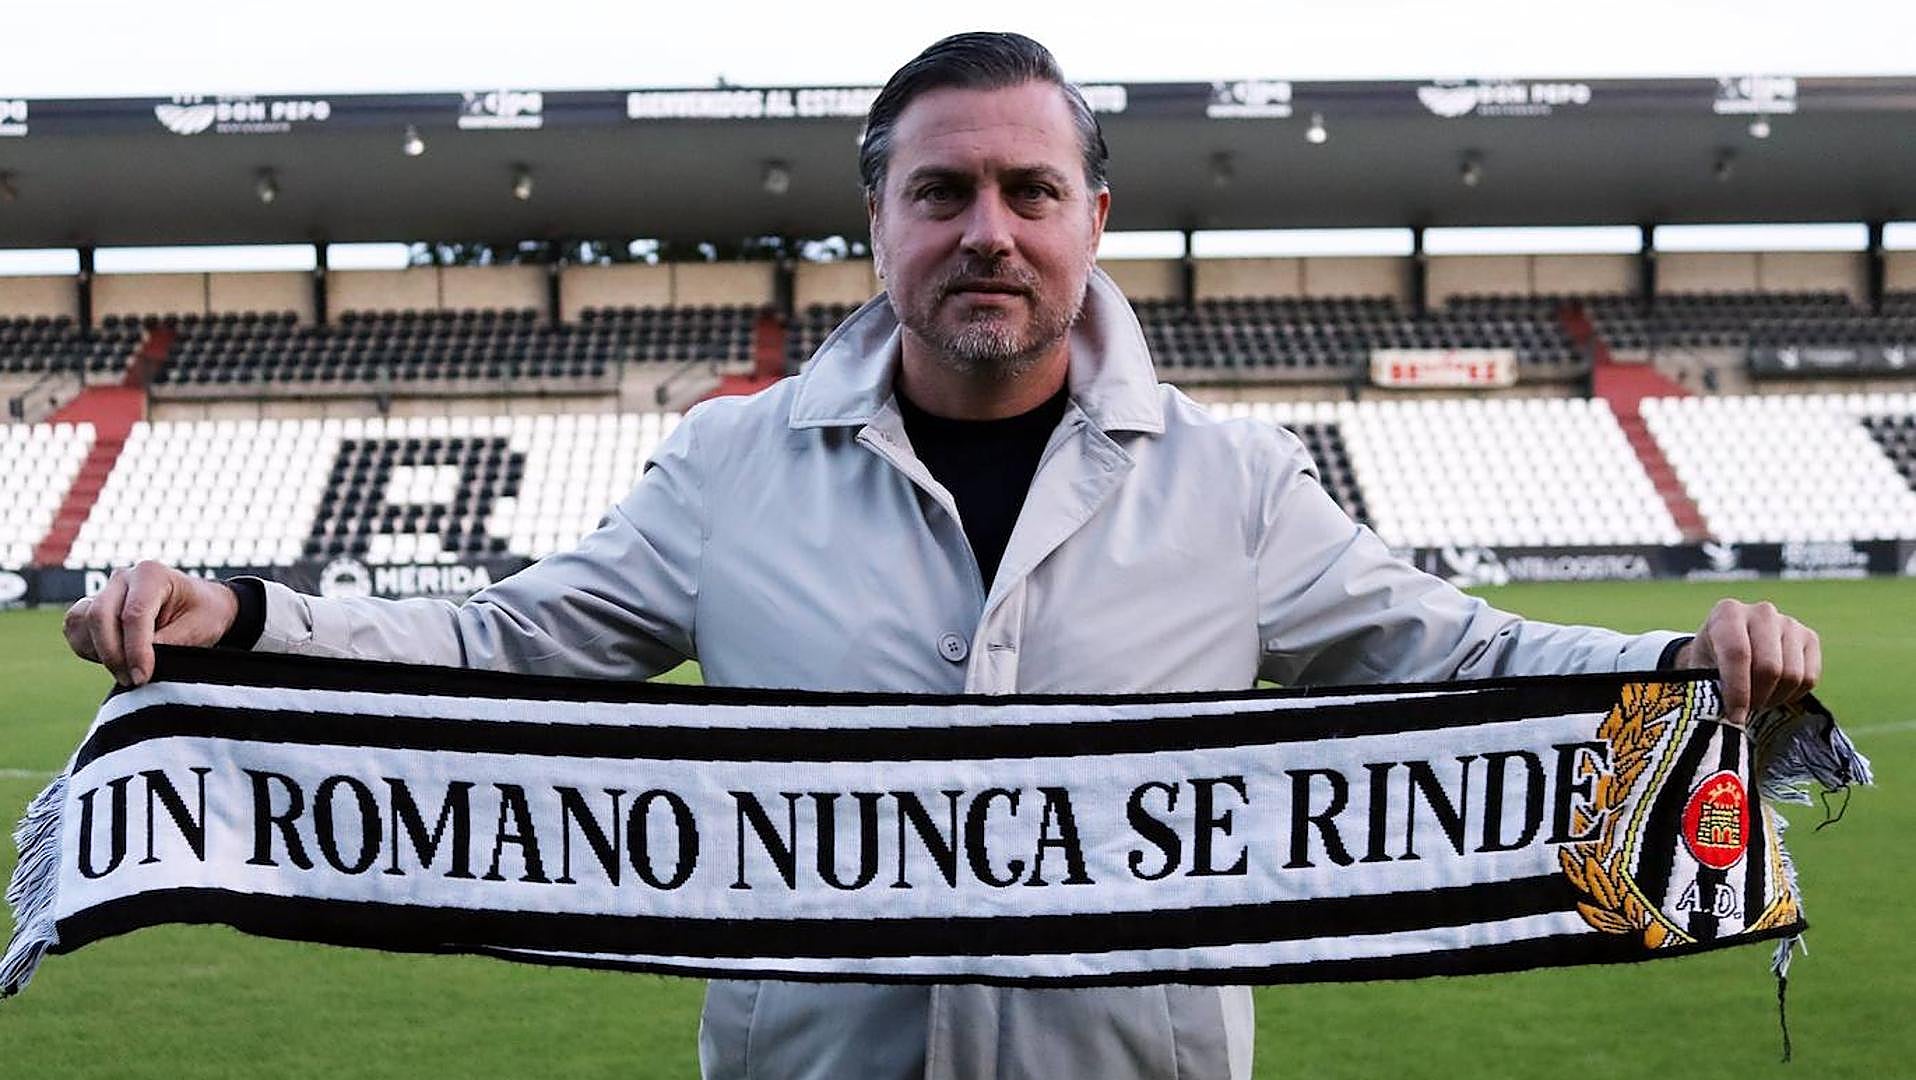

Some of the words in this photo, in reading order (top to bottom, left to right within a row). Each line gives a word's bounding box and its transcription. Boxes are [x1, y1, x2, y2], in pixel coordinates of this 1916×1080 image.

[78, 767, 212, 880] UN
[241, 767, 700, 891] ROMANO
[728, 786, 1095, 891] NUNCA
[1127, 775, 1250, 881] SE
[1282, 740, 1610, 870] RINDE
